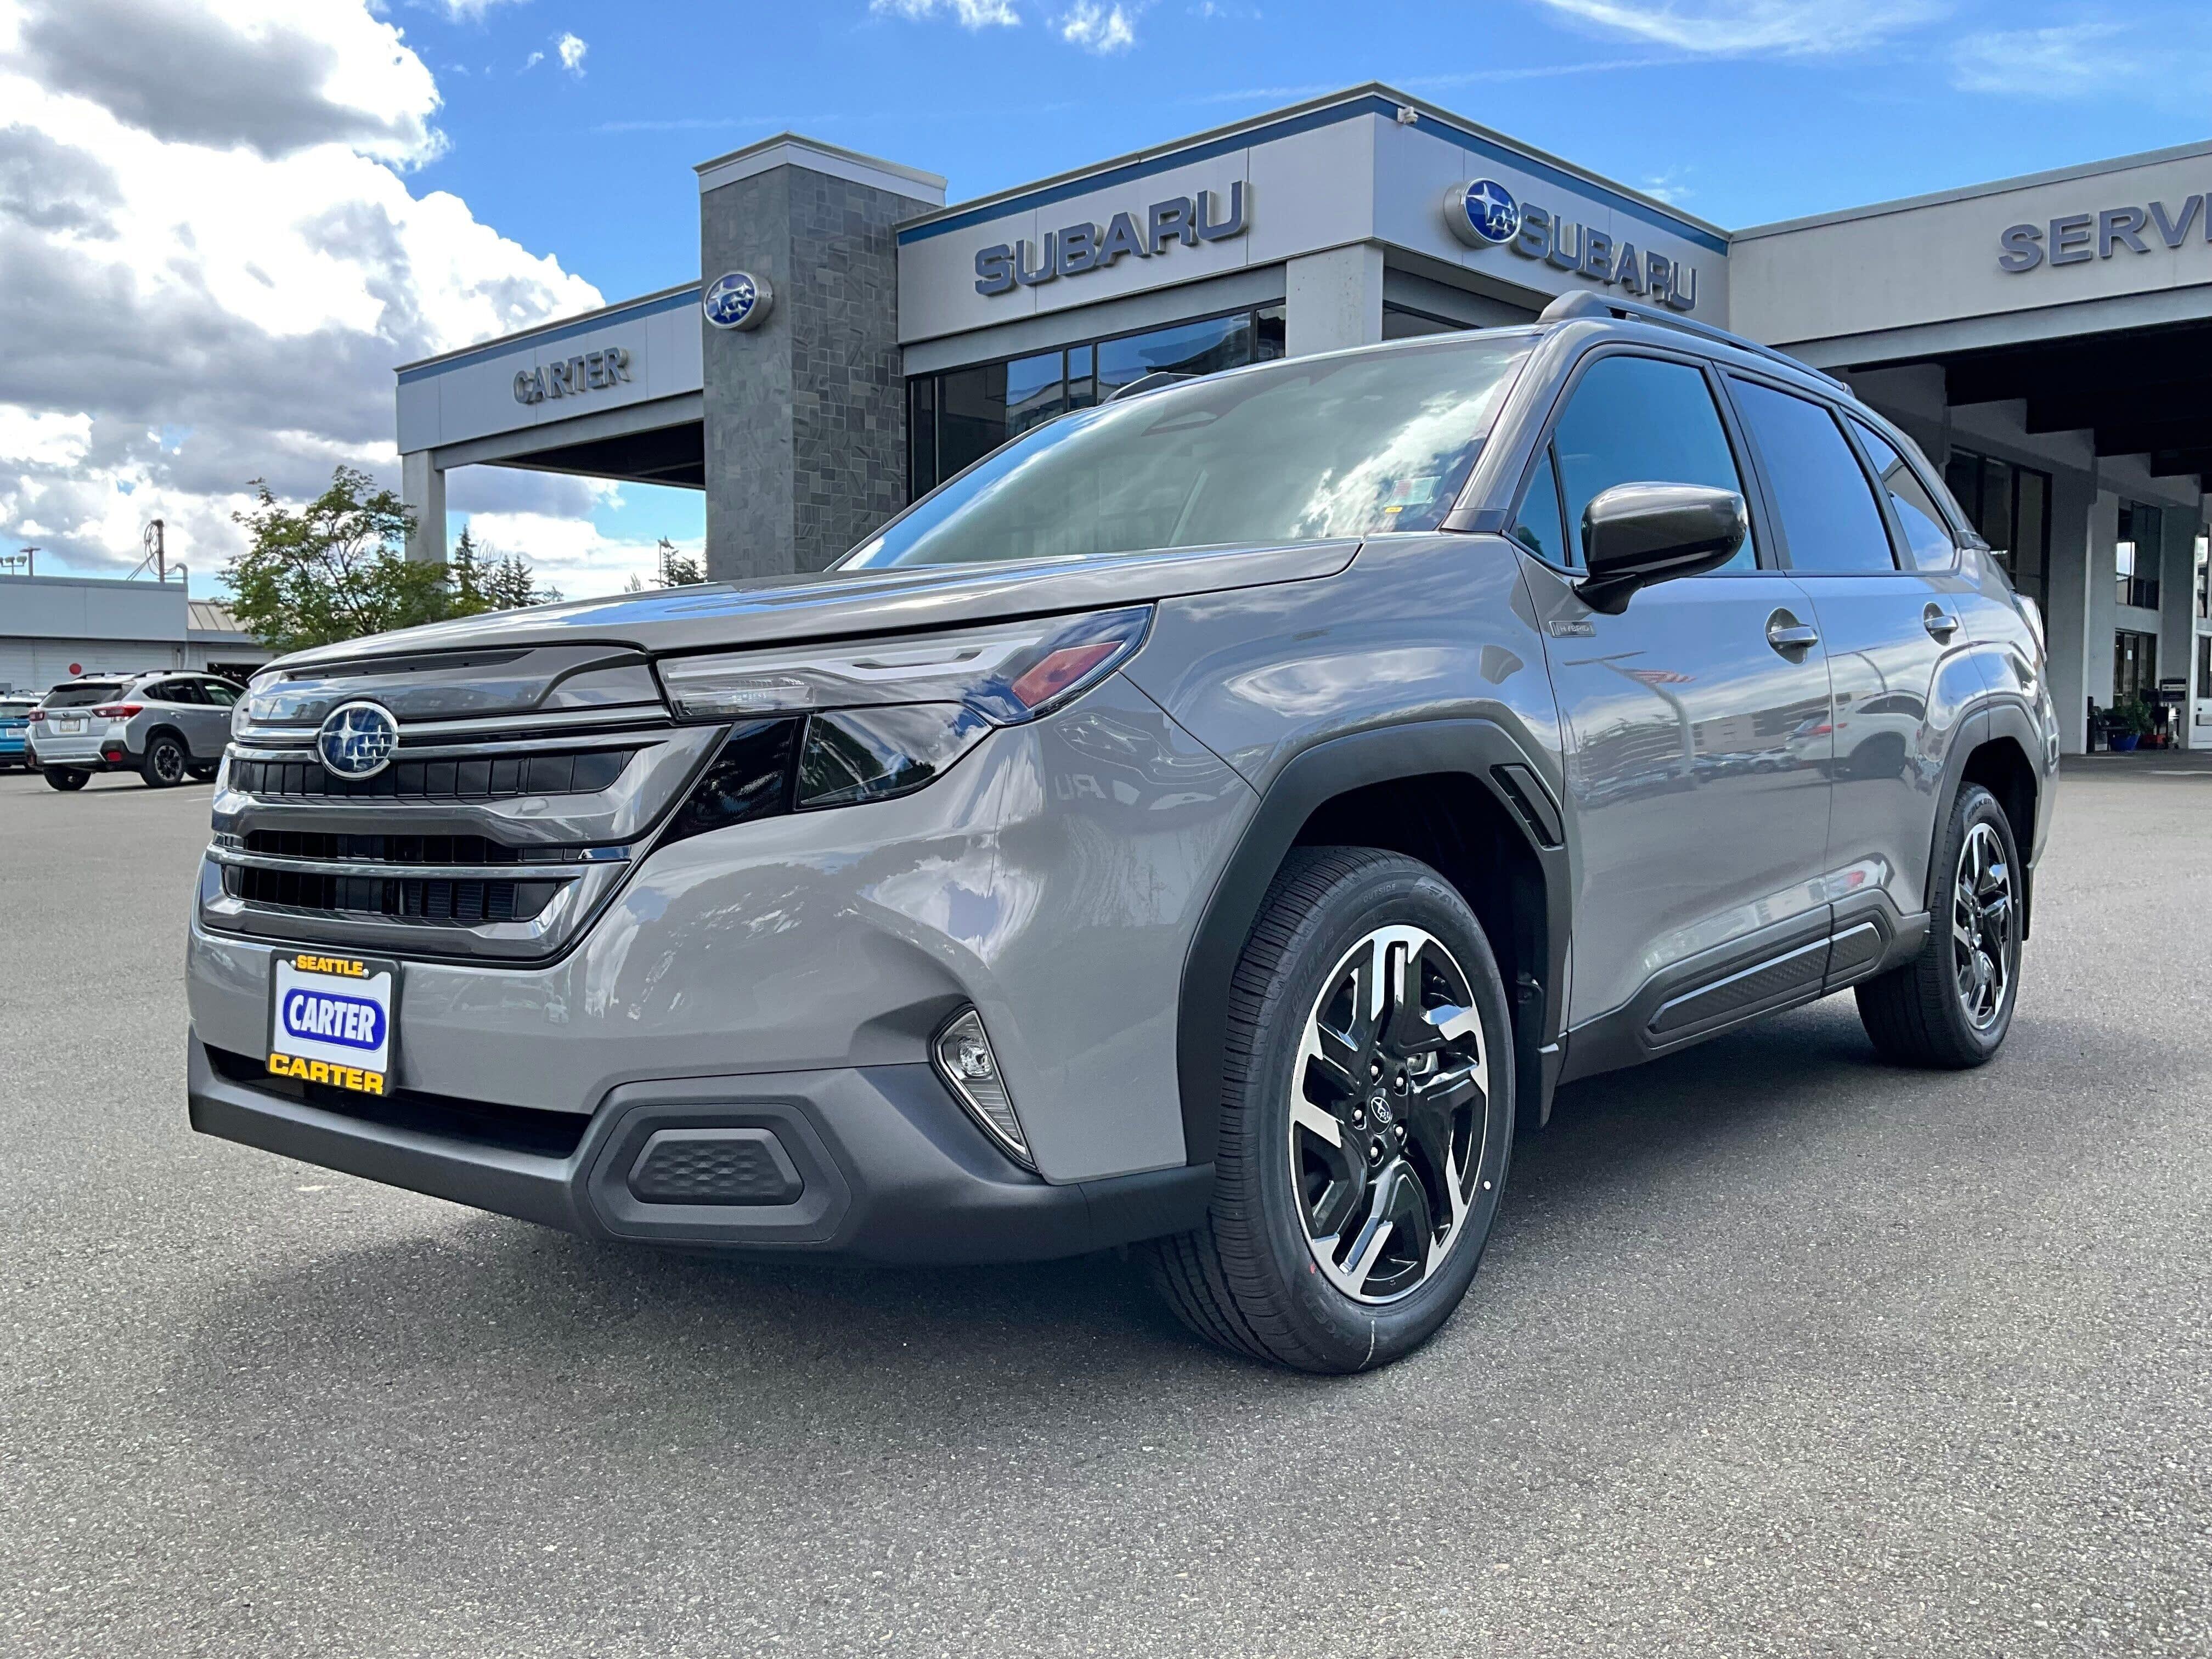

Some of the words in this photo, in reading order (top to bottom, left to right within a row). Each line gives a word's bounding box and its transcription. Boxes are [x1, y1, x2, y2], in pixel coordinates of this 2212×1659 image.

[974, 180, 1249, 296] SUBARU
[1515, 202, 1697, 311] SUBARU
[513, 346, 629, 405] CARTER
[1559, 624, 1590, 633] HYBRID
[1363, 883, 1396, 904] OUTSIDE
[296, 954, 363, 977] SEATTLE
[289, 994, 376, 1043] CARTER
[269, 1053, 384, 1095] CARTER
